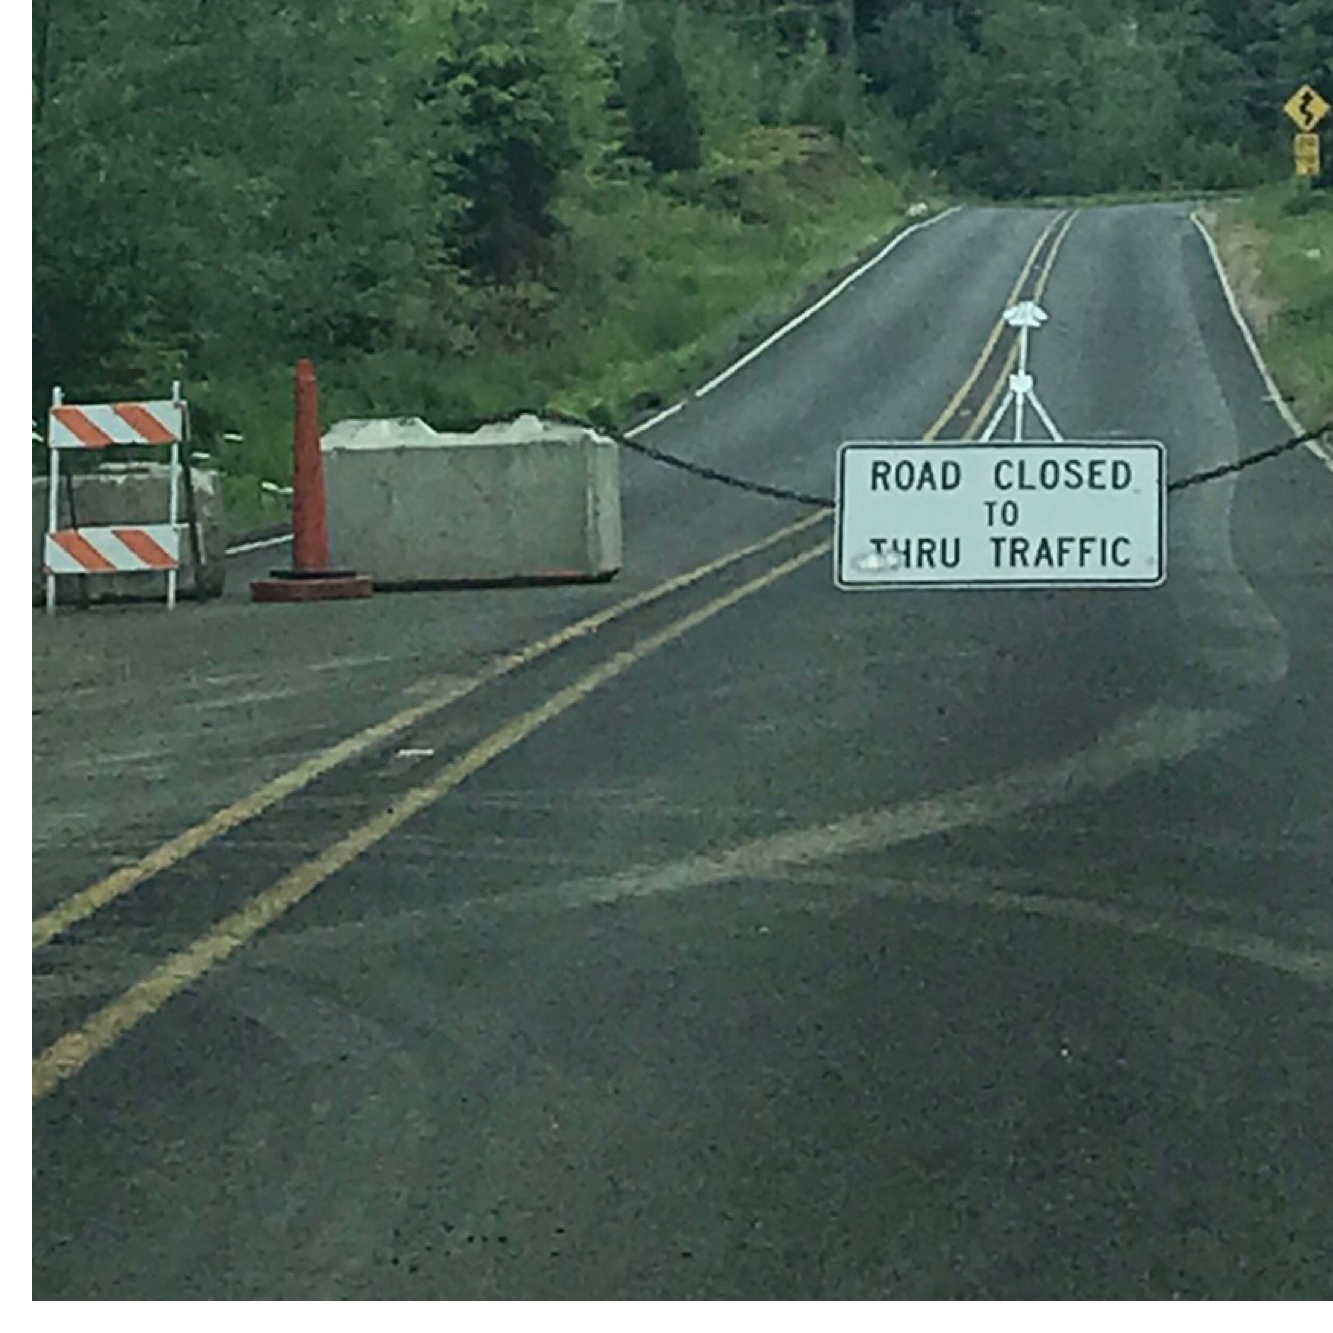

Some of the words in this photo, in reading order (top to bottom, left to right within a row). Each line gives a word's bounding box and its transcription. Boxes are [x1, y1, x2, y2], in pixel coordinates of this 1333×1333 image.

[870, 460, 961, 491] ROAD
[994, 460, 1132, 490] CLOSED
[984, 501, 1018, 527] TO
[870, 538, 961, 568] THRU
[990, 537, 1131, 567] TRAFFIC
